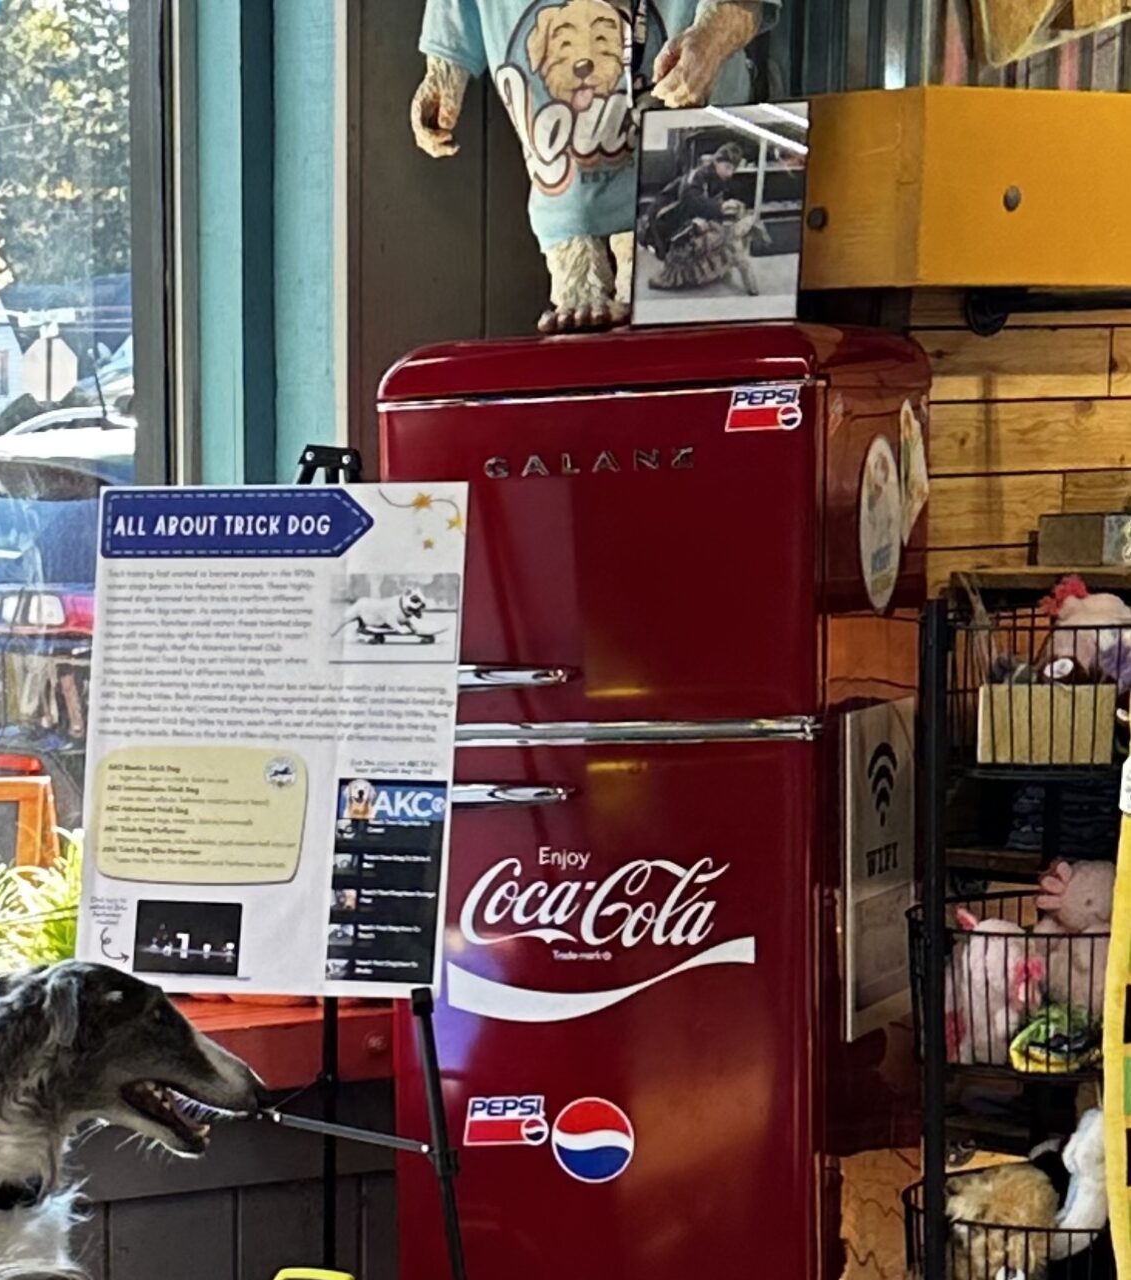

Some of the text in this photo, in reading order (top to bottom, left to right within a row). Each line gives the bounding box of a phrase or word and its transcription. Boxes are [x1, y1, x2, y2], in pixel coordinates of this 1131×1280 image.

[495, 65, 639, 188] Lou
[732, 389, 797, 406] PEPSI
[483, 448, 694, 478] GALANZ
[113, 515, 331, 536] ALL ABOUT TRICK DOG
[372, 790, 434, 818] AKC
[538, 847, 590, 870] Enjoy
[866, 842, 898, 878] WIFI
[460, 857, 730, 947] Coca-Cola
[470, 1098, 542, 1116] PEPSI
